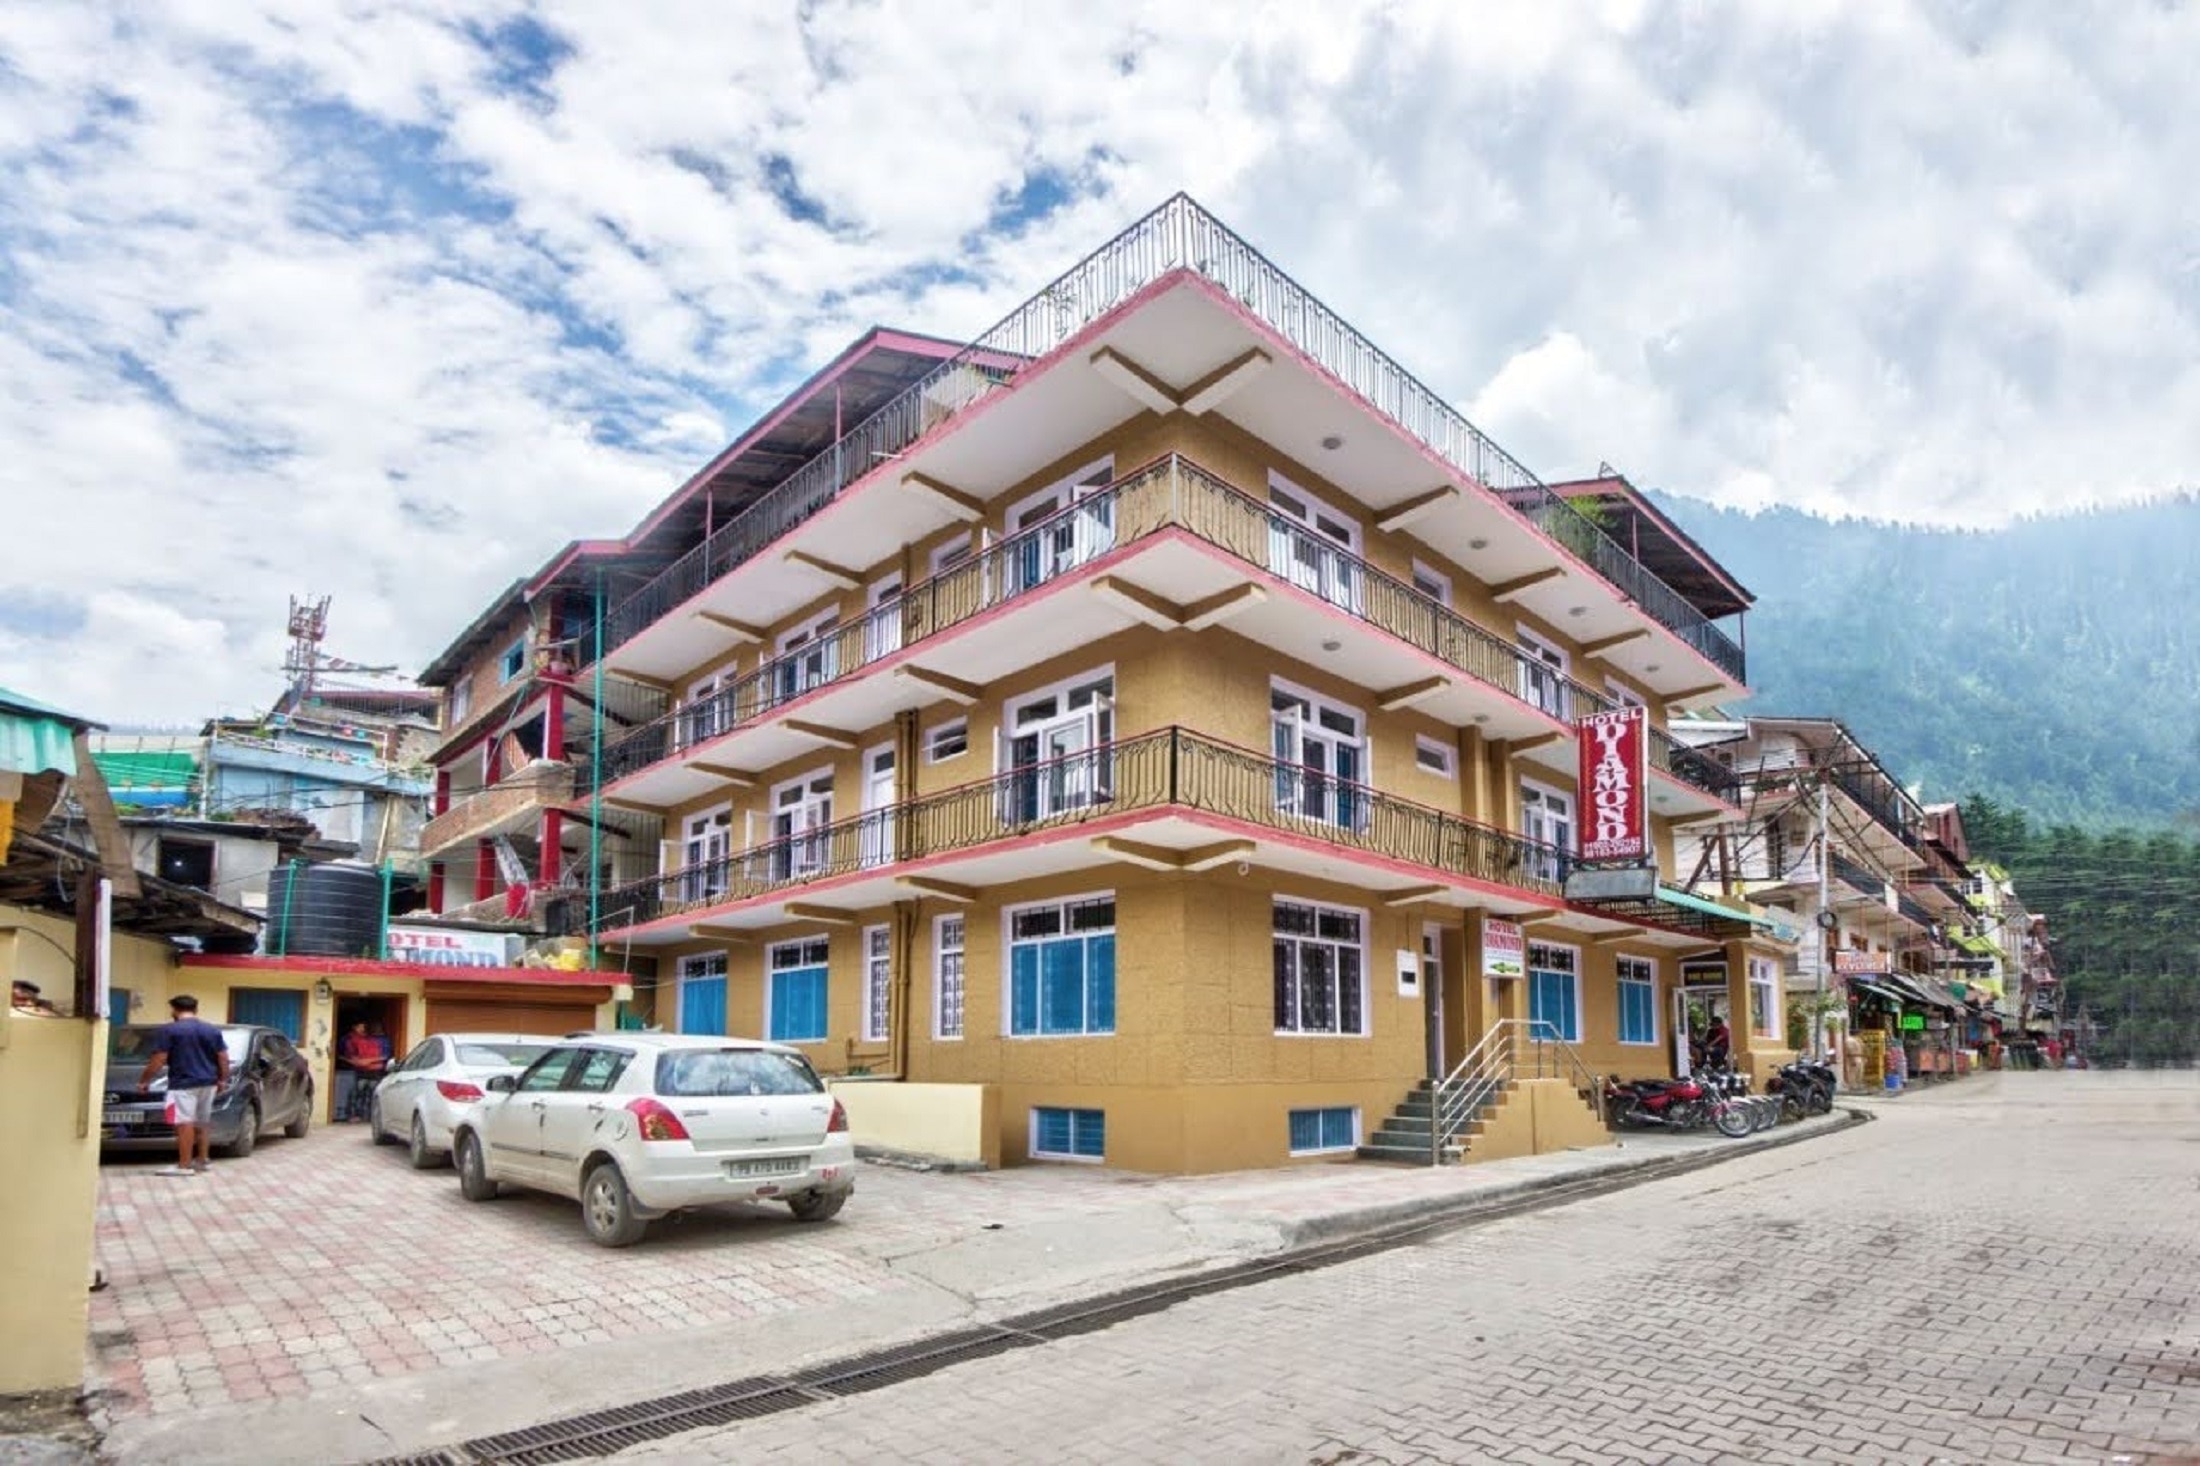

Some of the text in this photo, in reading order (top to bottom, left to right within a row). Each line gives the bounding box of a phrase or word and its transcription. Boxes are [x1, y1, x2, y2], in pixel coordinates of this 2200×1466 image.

[1582, 709, 1641, 728] HOTEL
[1592, 723, 1632, 841] DIAMOND
[1487, 919, 1518, 936] HOTEL
[388, 933, 462, 949] OTEL
[1486, 932, 1522, 951] DIAMOND
